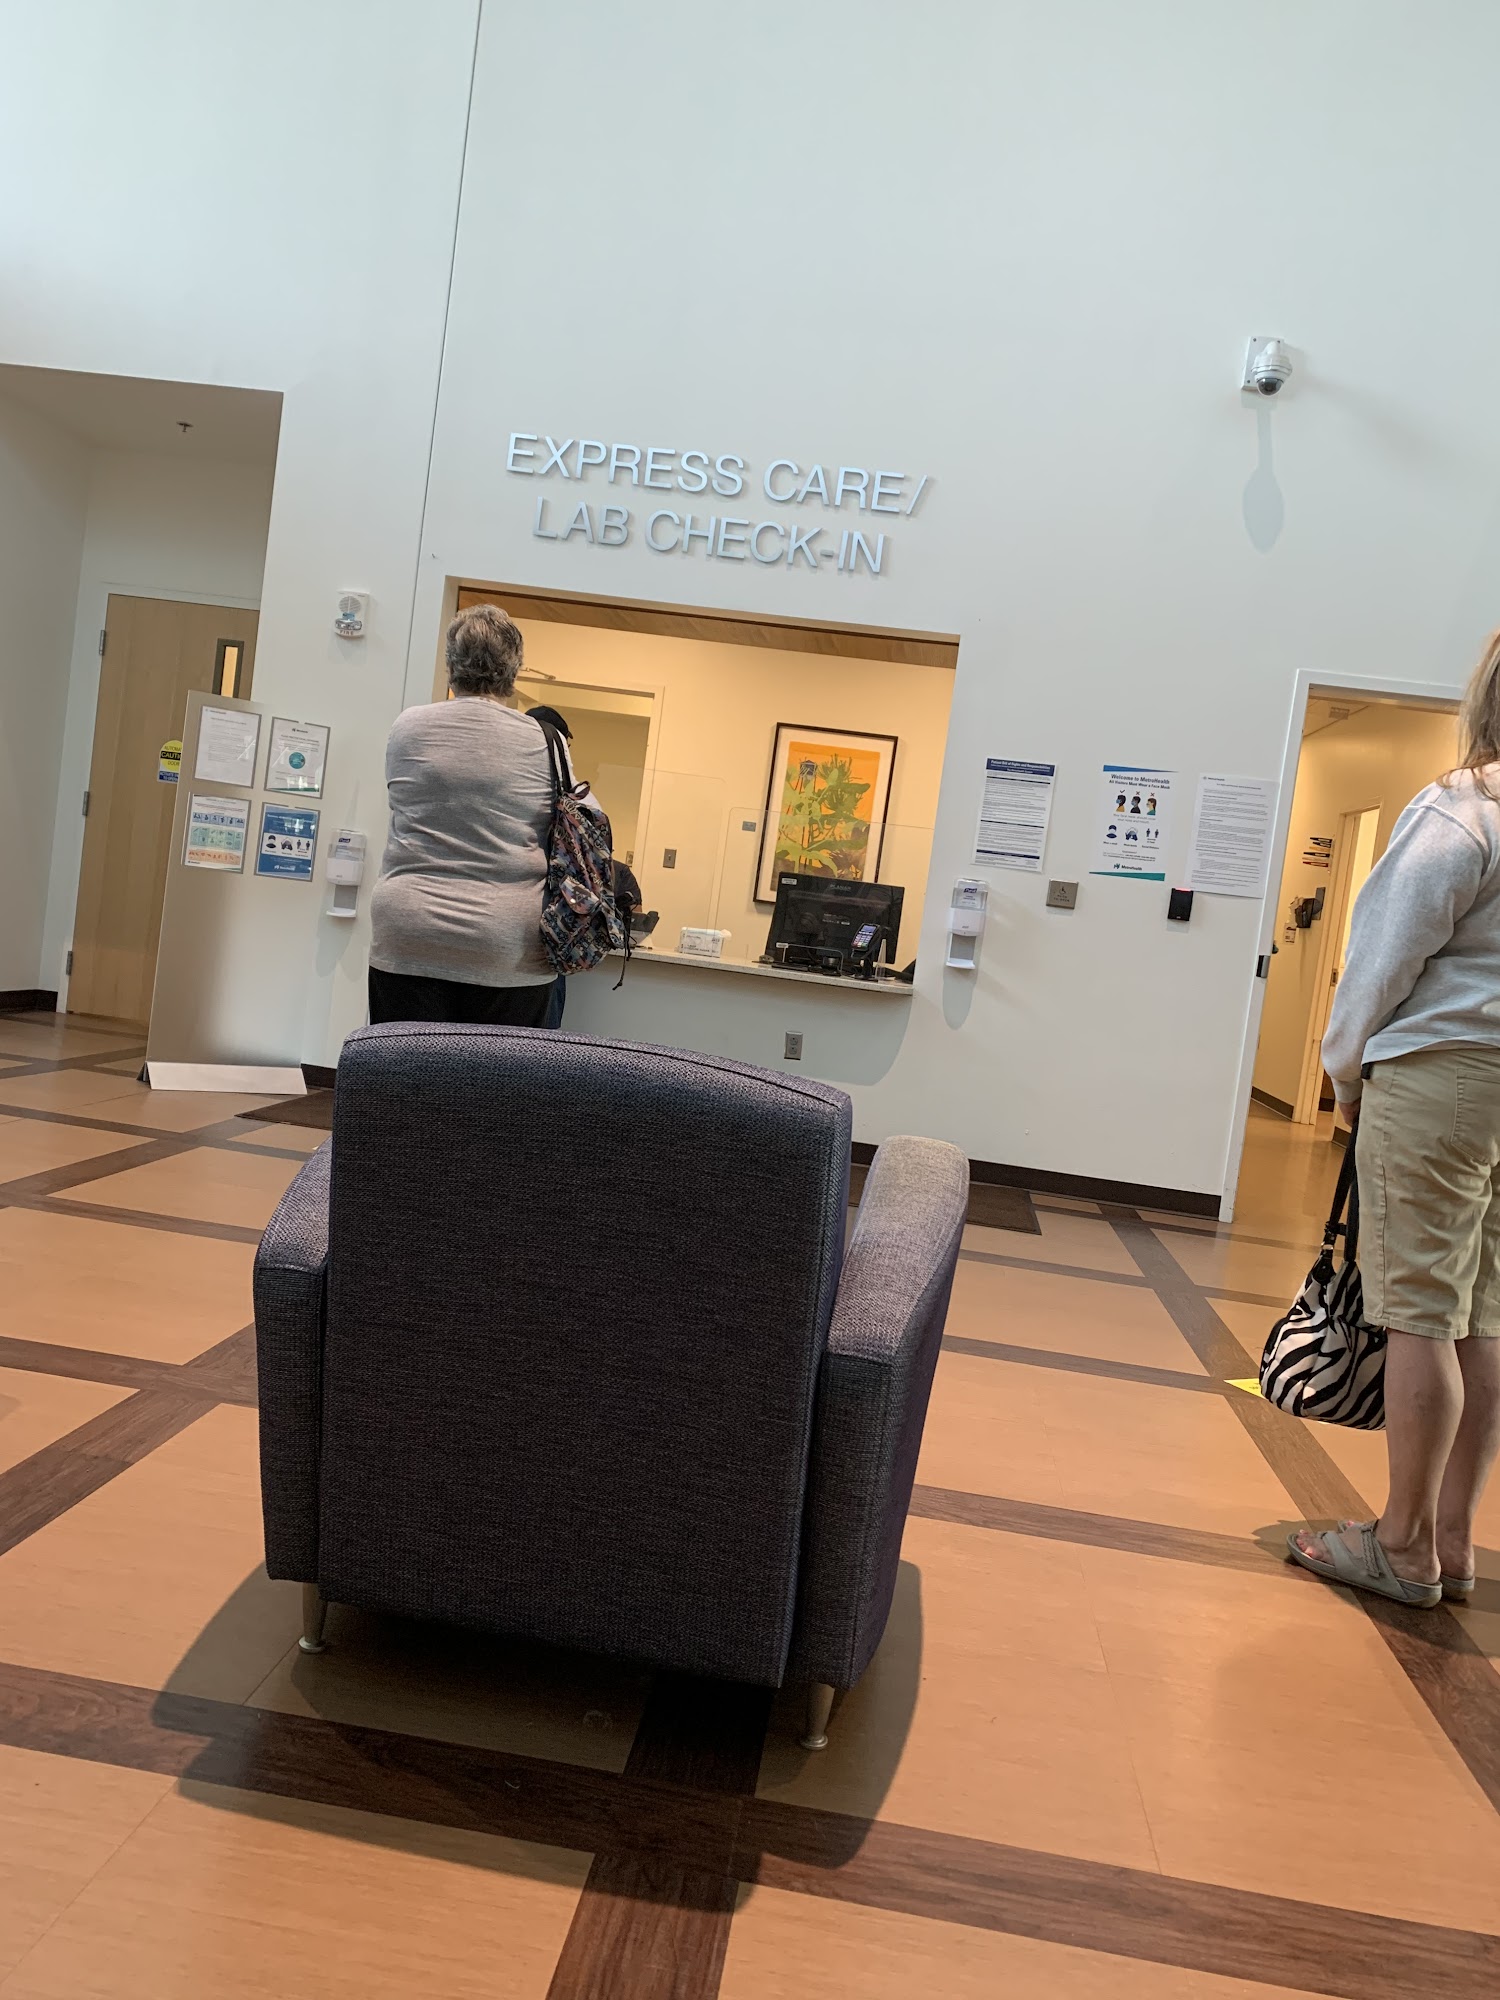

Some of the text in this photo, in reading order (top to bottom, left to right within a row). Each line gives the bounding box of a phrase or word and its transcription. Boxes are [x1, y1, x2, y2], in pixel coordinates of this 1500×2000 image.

[506, 432, 928, 515] EXPRESS CARE/
[532, 496, 885, 574] LAB CHECK-IN
